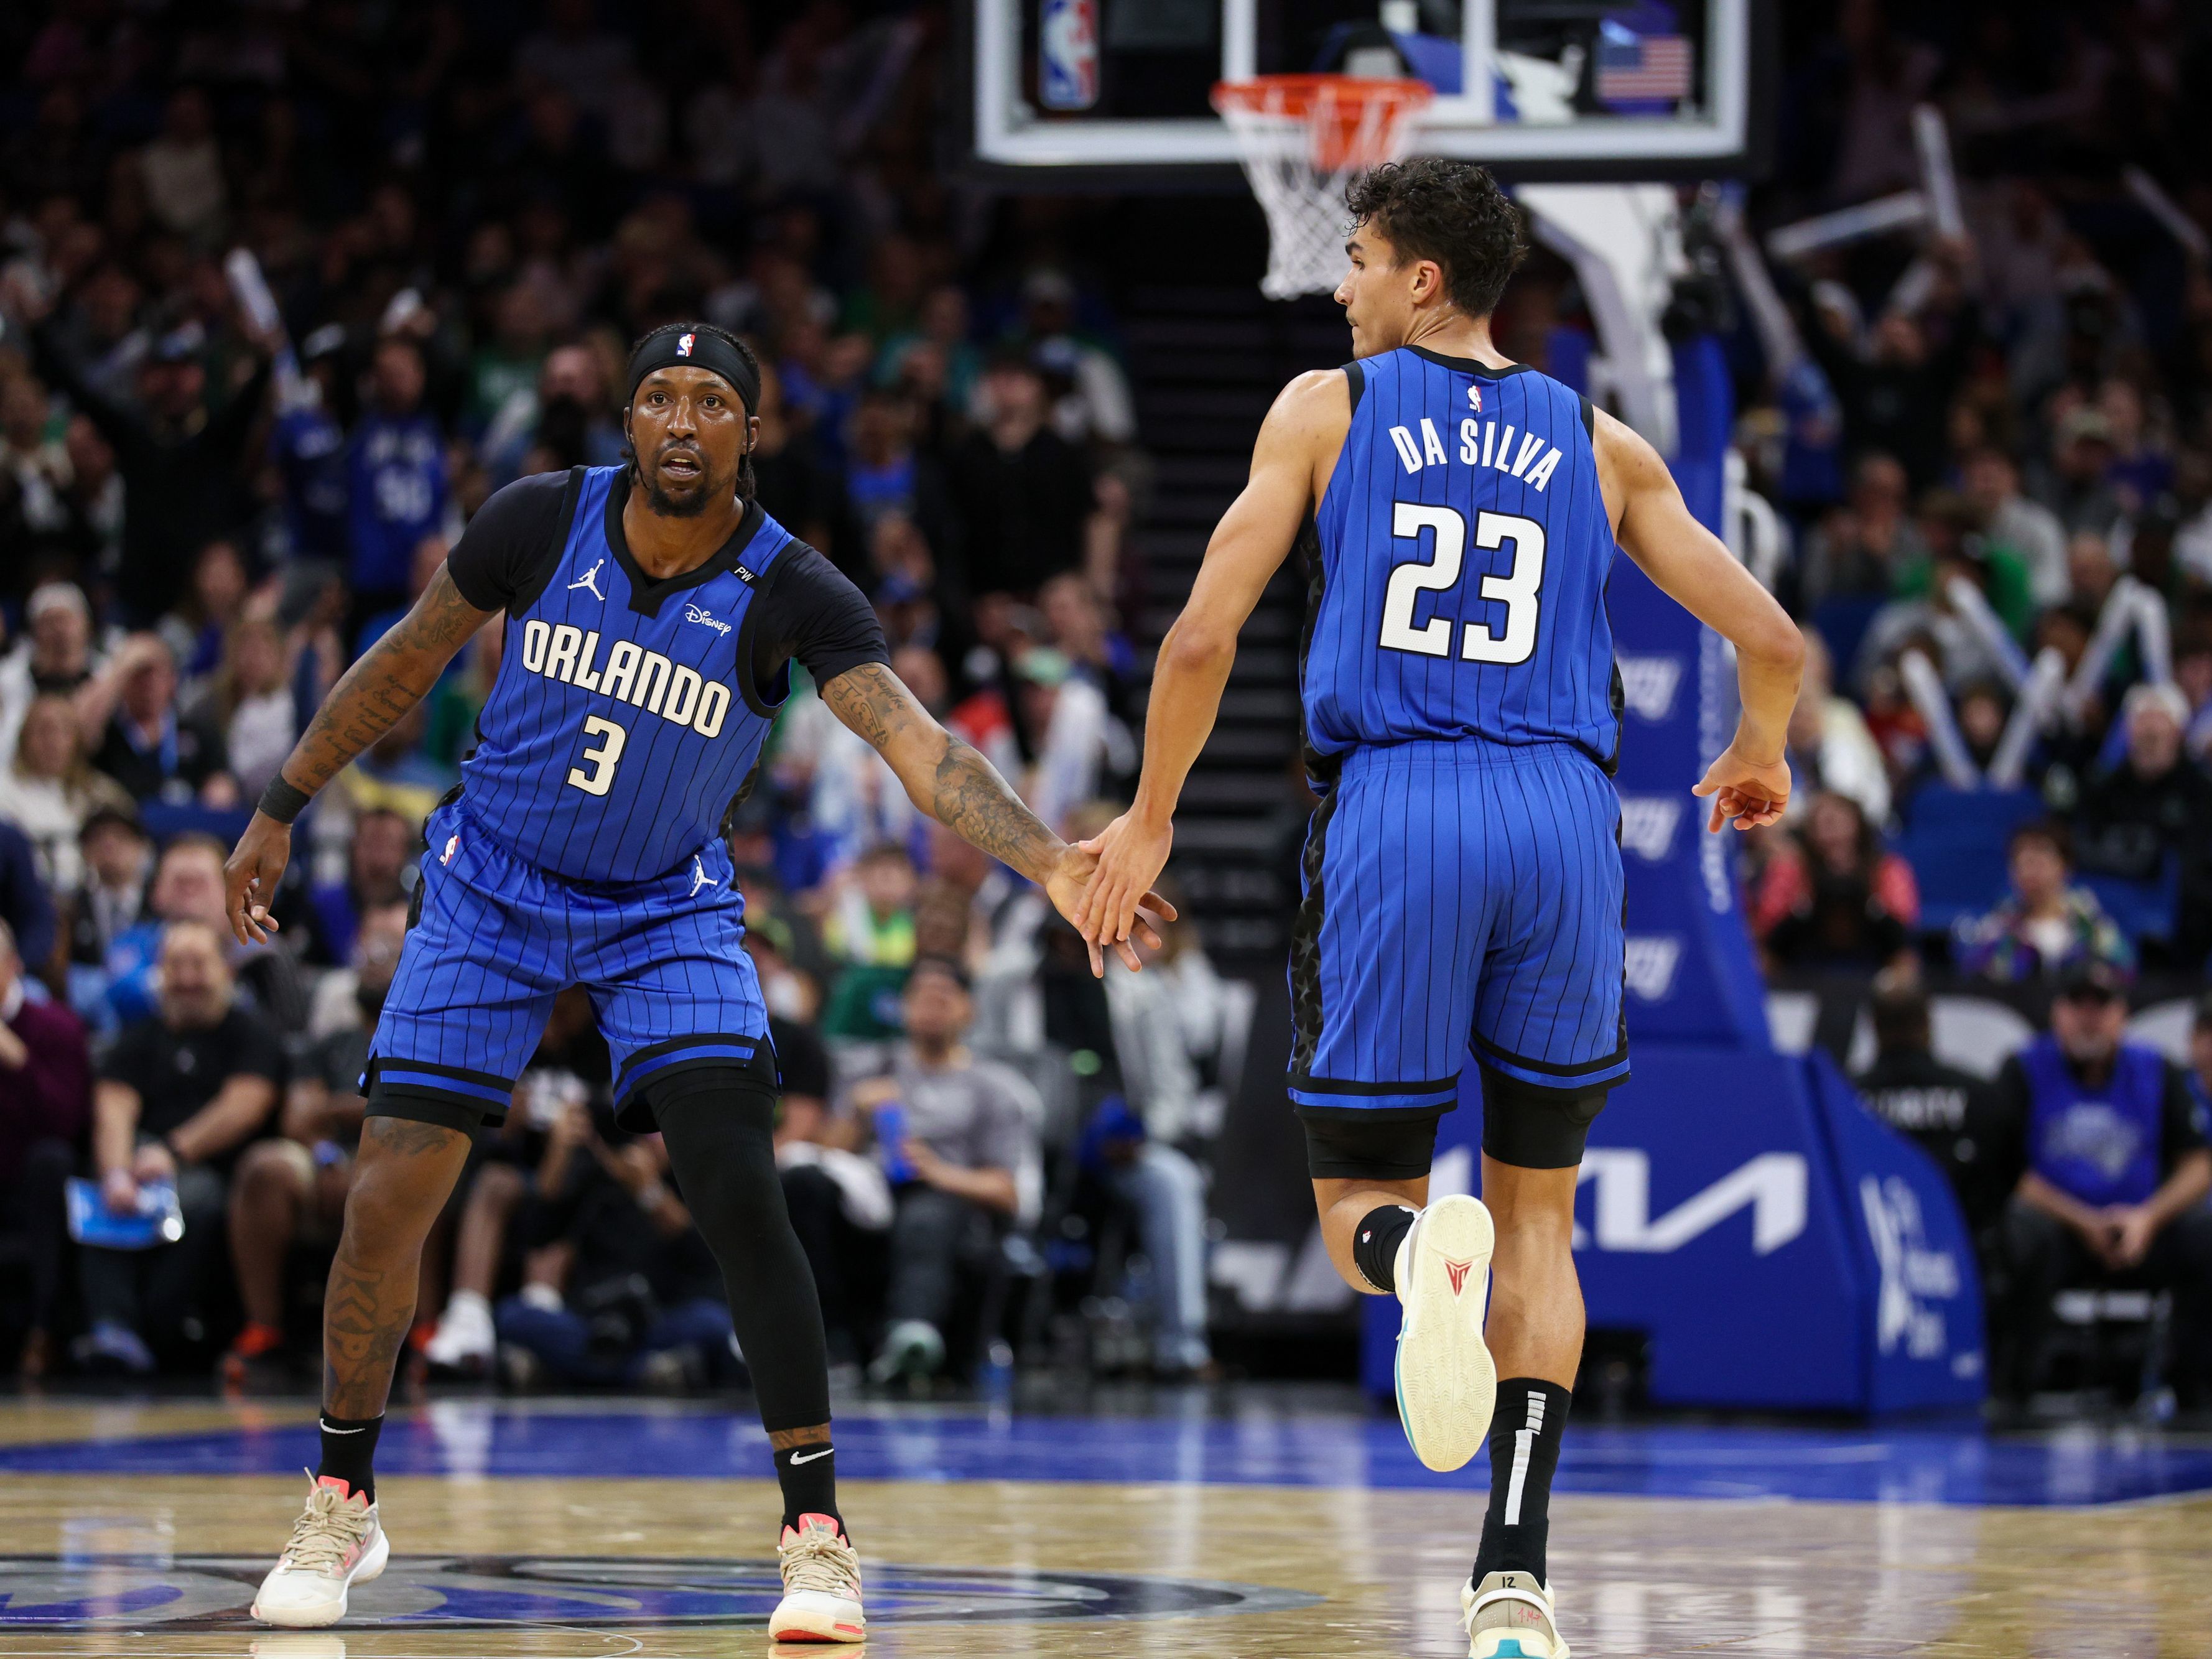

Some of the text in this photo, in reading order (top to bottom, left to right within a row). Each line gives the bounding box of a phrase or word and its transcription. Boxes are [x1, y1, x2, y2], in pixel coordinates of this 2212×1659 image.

[1388, 417, 1563, 493] DA SILVA
[734, 566, 755, 582] PW
[1377, 500, 1548, 667] 23
[522, 618, 732, 739] ORLANDO
[566, 713, 626, 797] 3
[1502, 1576, 1517, 1588] 12
